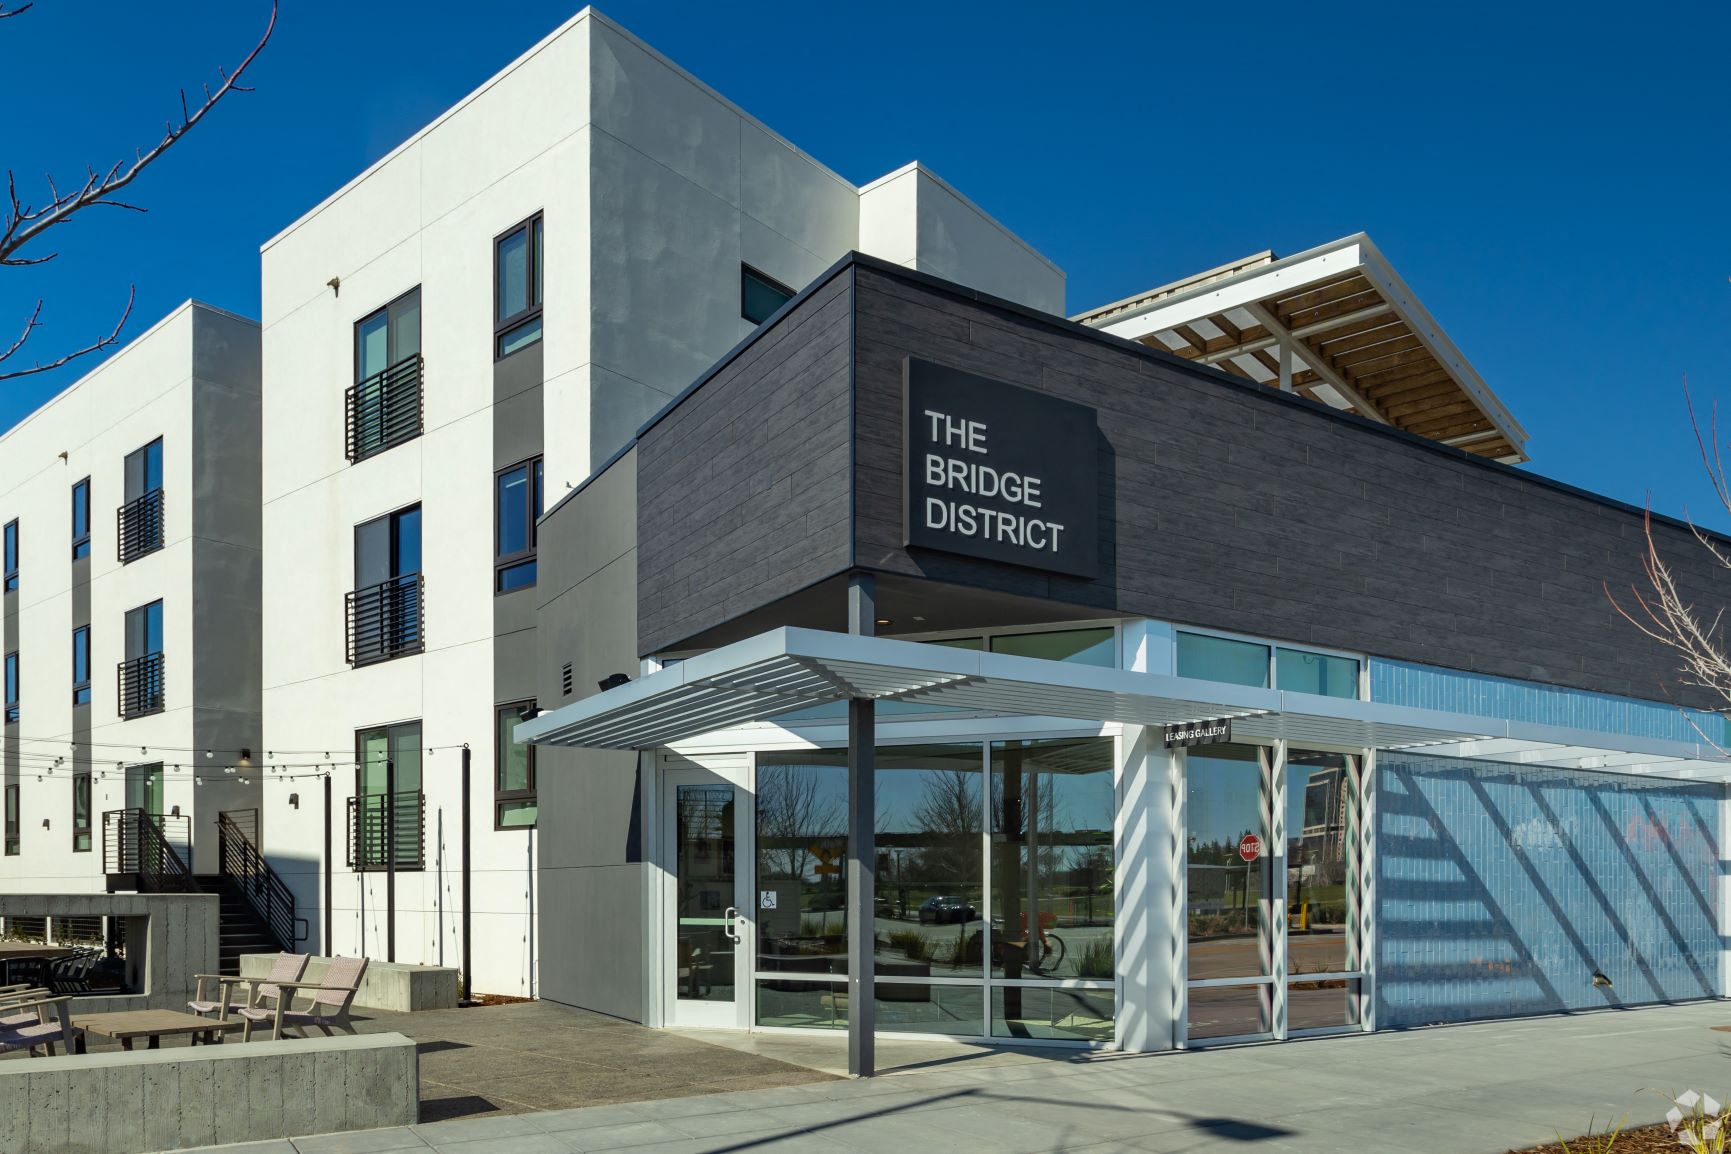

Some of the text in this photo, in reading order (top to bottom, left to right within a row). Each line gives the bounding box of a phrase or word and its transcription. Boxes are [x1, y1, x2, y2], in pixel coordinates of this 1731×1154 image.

[924, 409, 988, 454] THE
[926, 453, 1042, 508] BRIDGE
[926, 497, 1065, 552] DISTRICT
[1165, 726, 1227, 742] LEASING GALLERY
